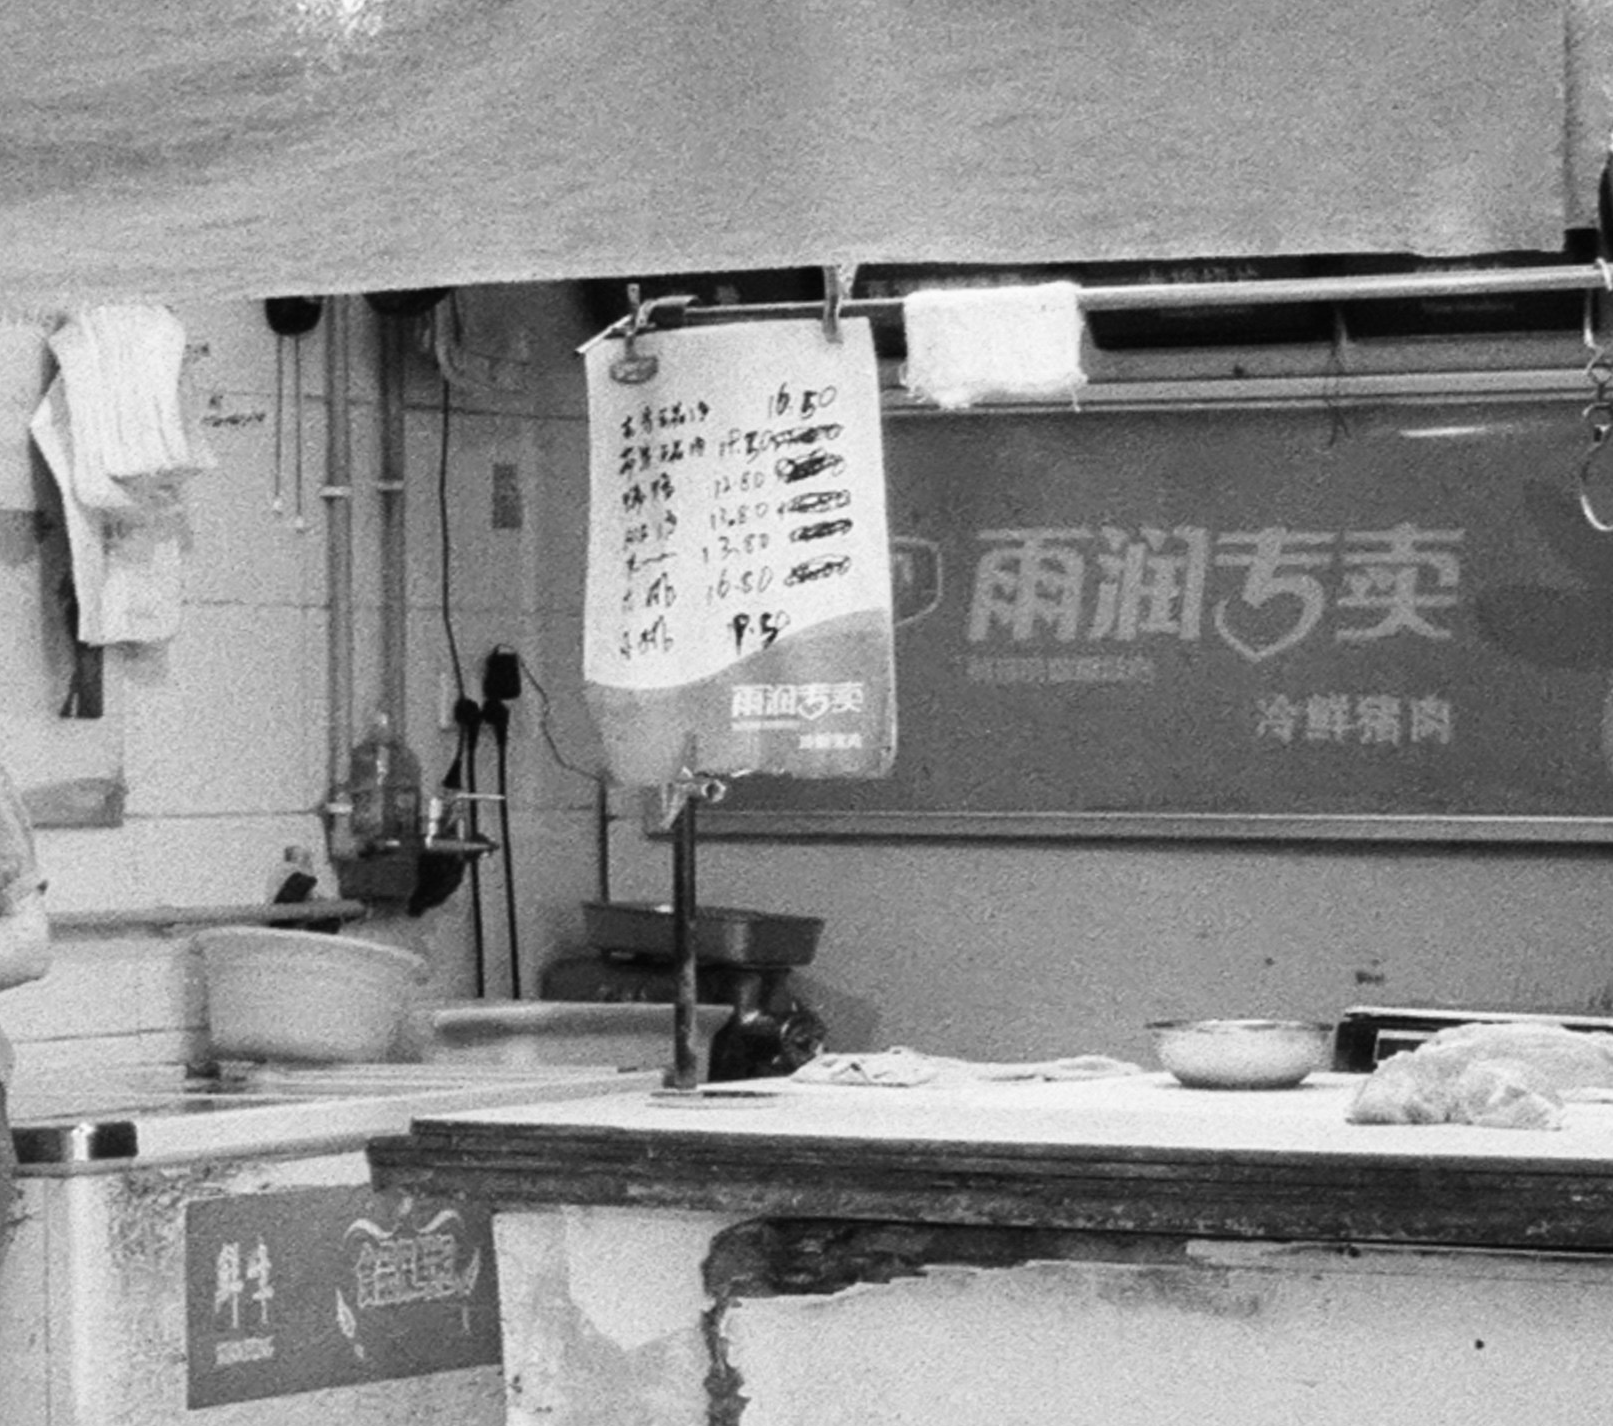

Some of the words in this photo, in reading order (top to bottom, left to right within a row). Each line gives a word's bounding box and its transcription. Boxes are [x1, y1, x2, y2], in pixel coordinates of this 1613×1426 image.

[966, 523, 1466, 662] 雨润专卖
[1255, 694, 1453, 745] 冷鲜猪肉
